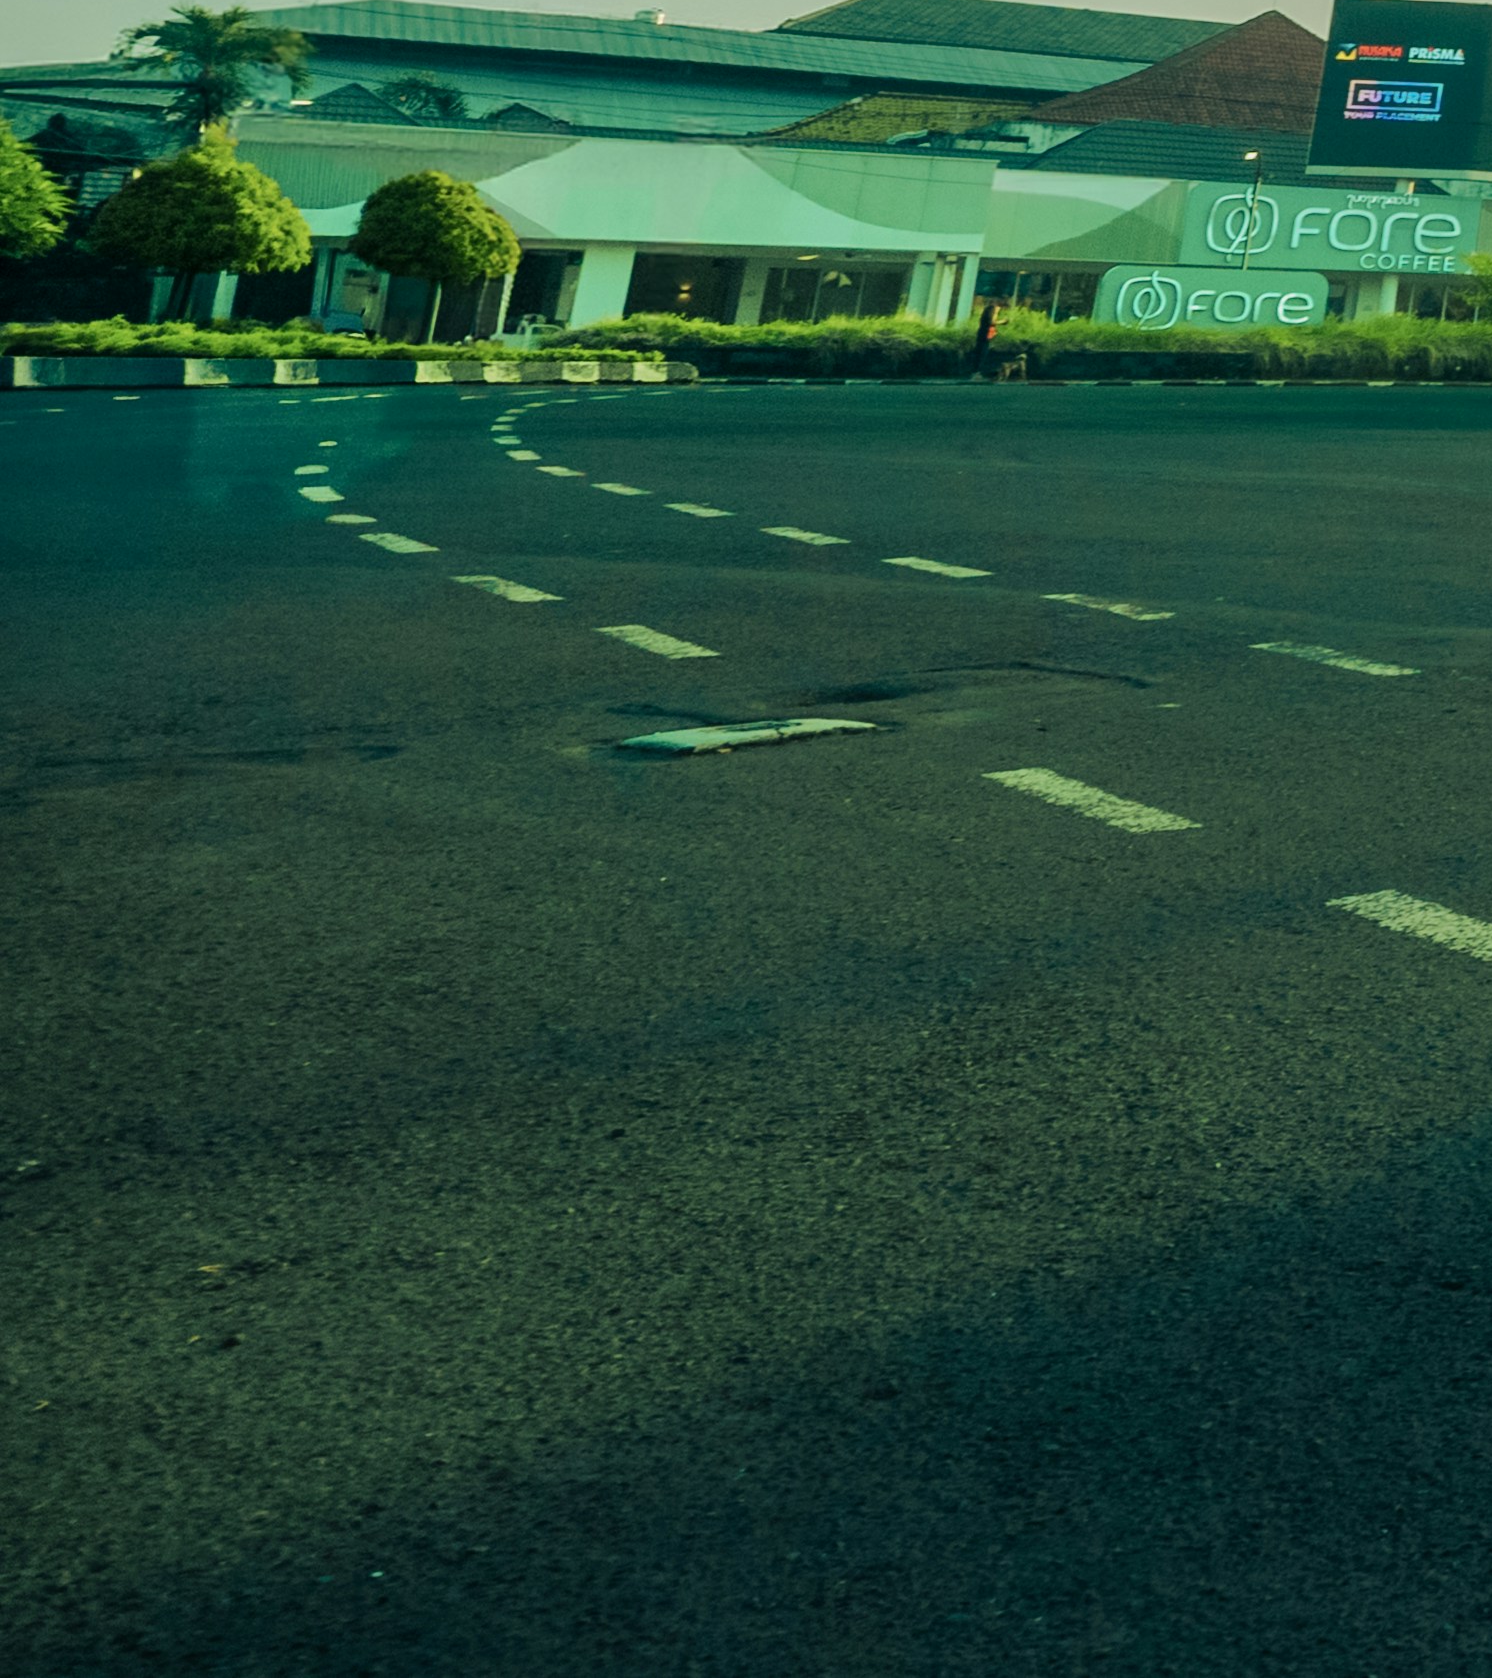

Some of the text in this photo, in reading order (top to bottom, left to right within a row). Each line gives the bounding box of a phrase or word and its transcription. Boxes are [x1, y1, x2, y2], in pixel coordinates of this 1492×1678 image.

[1357, 89, 1433, 105] FUTURE
[1343, 110, 1442, 122] YOUR PLACEMENT
[1359, 252, 1456, 273] COFFEE
